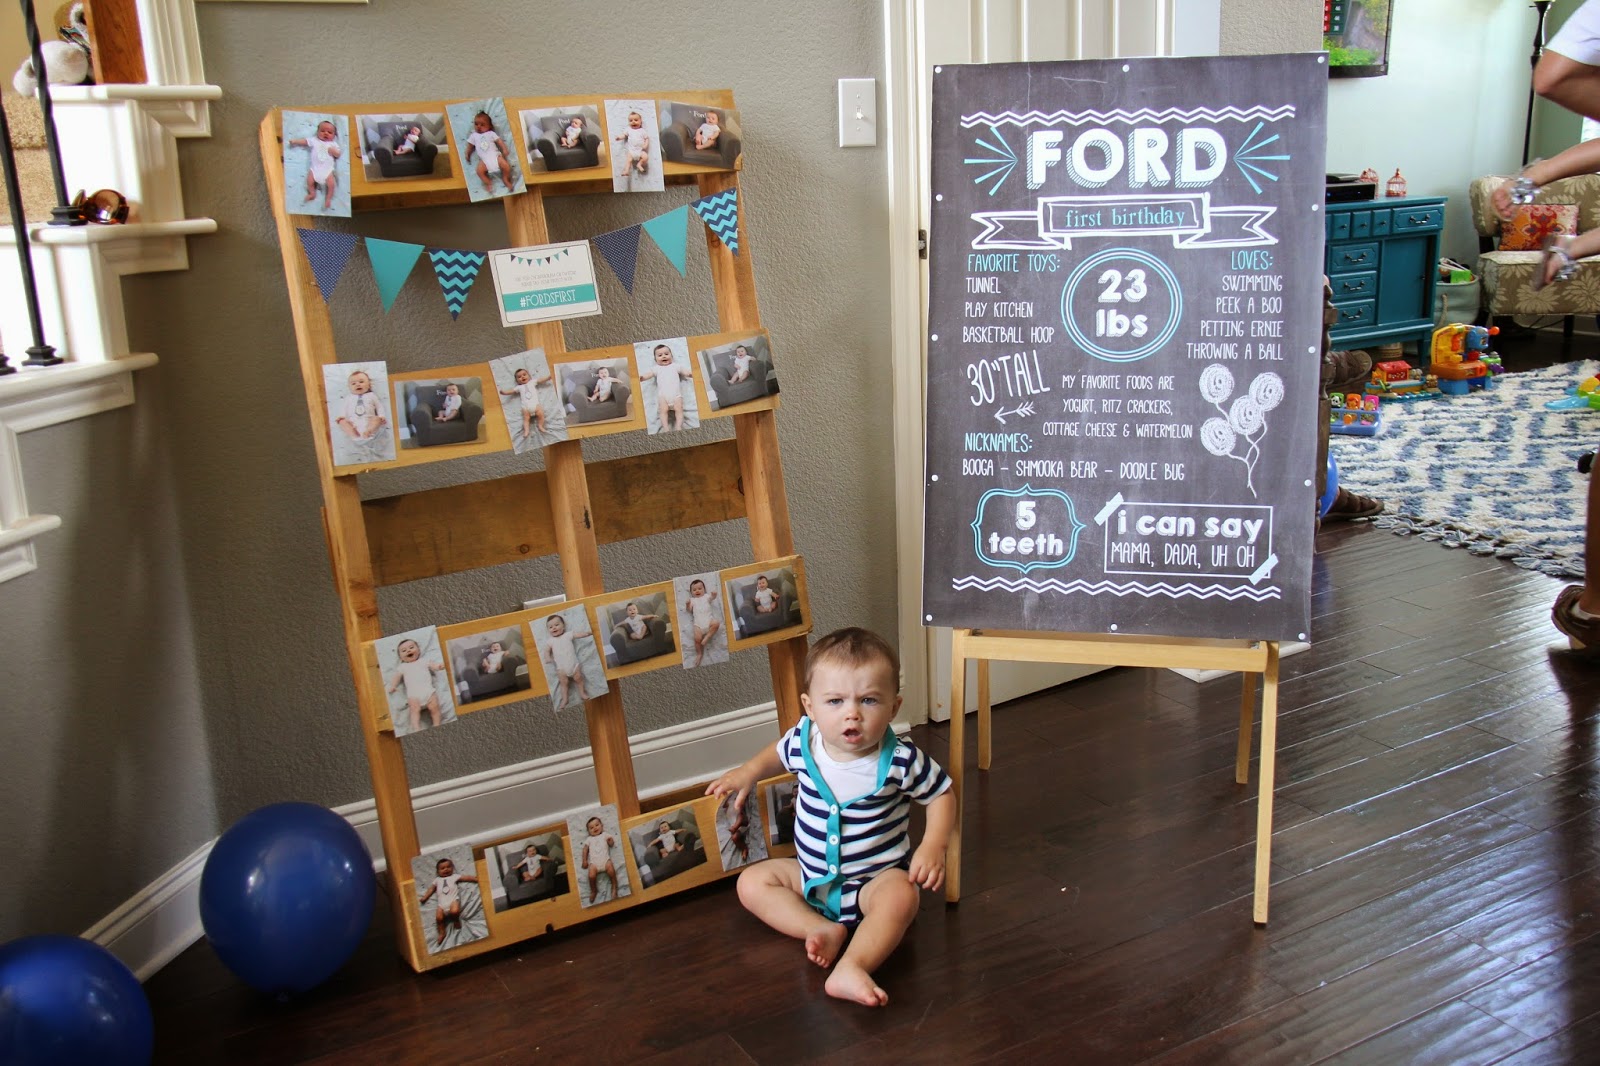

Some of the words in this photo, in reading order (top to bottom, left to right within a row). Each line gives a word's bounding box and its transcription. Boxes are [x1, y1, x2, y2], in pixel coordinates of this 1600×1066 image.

[1027, 128, 1228, 189] FORD
[1065, 208, 1101, 227] first
[1112, 206, 1185, 228] birthday
[968, 254, 1019, 272] FAVORITE
[1028, 255, 1060, 271] TOYS:
[1231, 251, 1273, 270] LOVES:
[966, 277, 1001, 294] TUNNEL
[1098, 269, 1147, 303] 23
[1222, 275, 1282, 292] SWIMMING
[520, 289, 576, 308] #FORDSFIRST
[1216, 297, 1241, 313] PEEK
[1248, 297, 1254, 313] A
[1261, 297, 1282, 313] BOO
[965, 302, 988, 318] PLAY
[993, 301, 1033, 318] KITCHEN
[1096, 309, 1148, 337] lbs
[1201, 320, 1244, 337] PETTING
[1251, 320, 1283, 337] ERNIE
[963, 327, 1024, 343] BASKETBALL
[1031, 327, 1055, 343] HOOP
[1187, 343, 1239, 360] THROWING
[1244, 343, 1252, 360] A
[1259, 343, 1283, 360] BALL
[1062, 375, 1076, 390] MY
[1081, 375, 1120, 390] FAVORITE
[1127, 376, 1153, 390] FOODS
[1159, 376, 1174, 390] ARE
[1063, 399, 1097, 415] YOGURT,
[1102, 400, 1121, 413] RITZ
[1127, 400, 1173, 415] CRACKERS,
[1043, 422, 1079, 436] COTTAGE
[1085, 422, 1118, 437] CHEESE
[1123, 423, 1129, 437] &
[1135, 424, 1193, 439] WATERMELON
[965, 433, 1033, 453] NICKNAMES:
[963, 459, 993, 476] BOOGA
[1016, 460, 1064, 477] SHMOOKA
[1071, 461, 1097, 478] BEAR
[1120, 462, 1157, 480] DOODLE
[1165, 463, 1184, 480] BUG
[1016, 501, 1037, 531] 5
[1118, 510, 1127, 534] i
[1136, 516, 1195, 538] can
[1204, 517, 1263, 544] say
[989, 530, 1063, 556] teeth
[1111, 542, 1154, 567] MAMA,
[1165, 542, 1201, 569] DADA,
[1212, 545, 1227, 567] UH
[1237, 545, 1254, 567] OH
